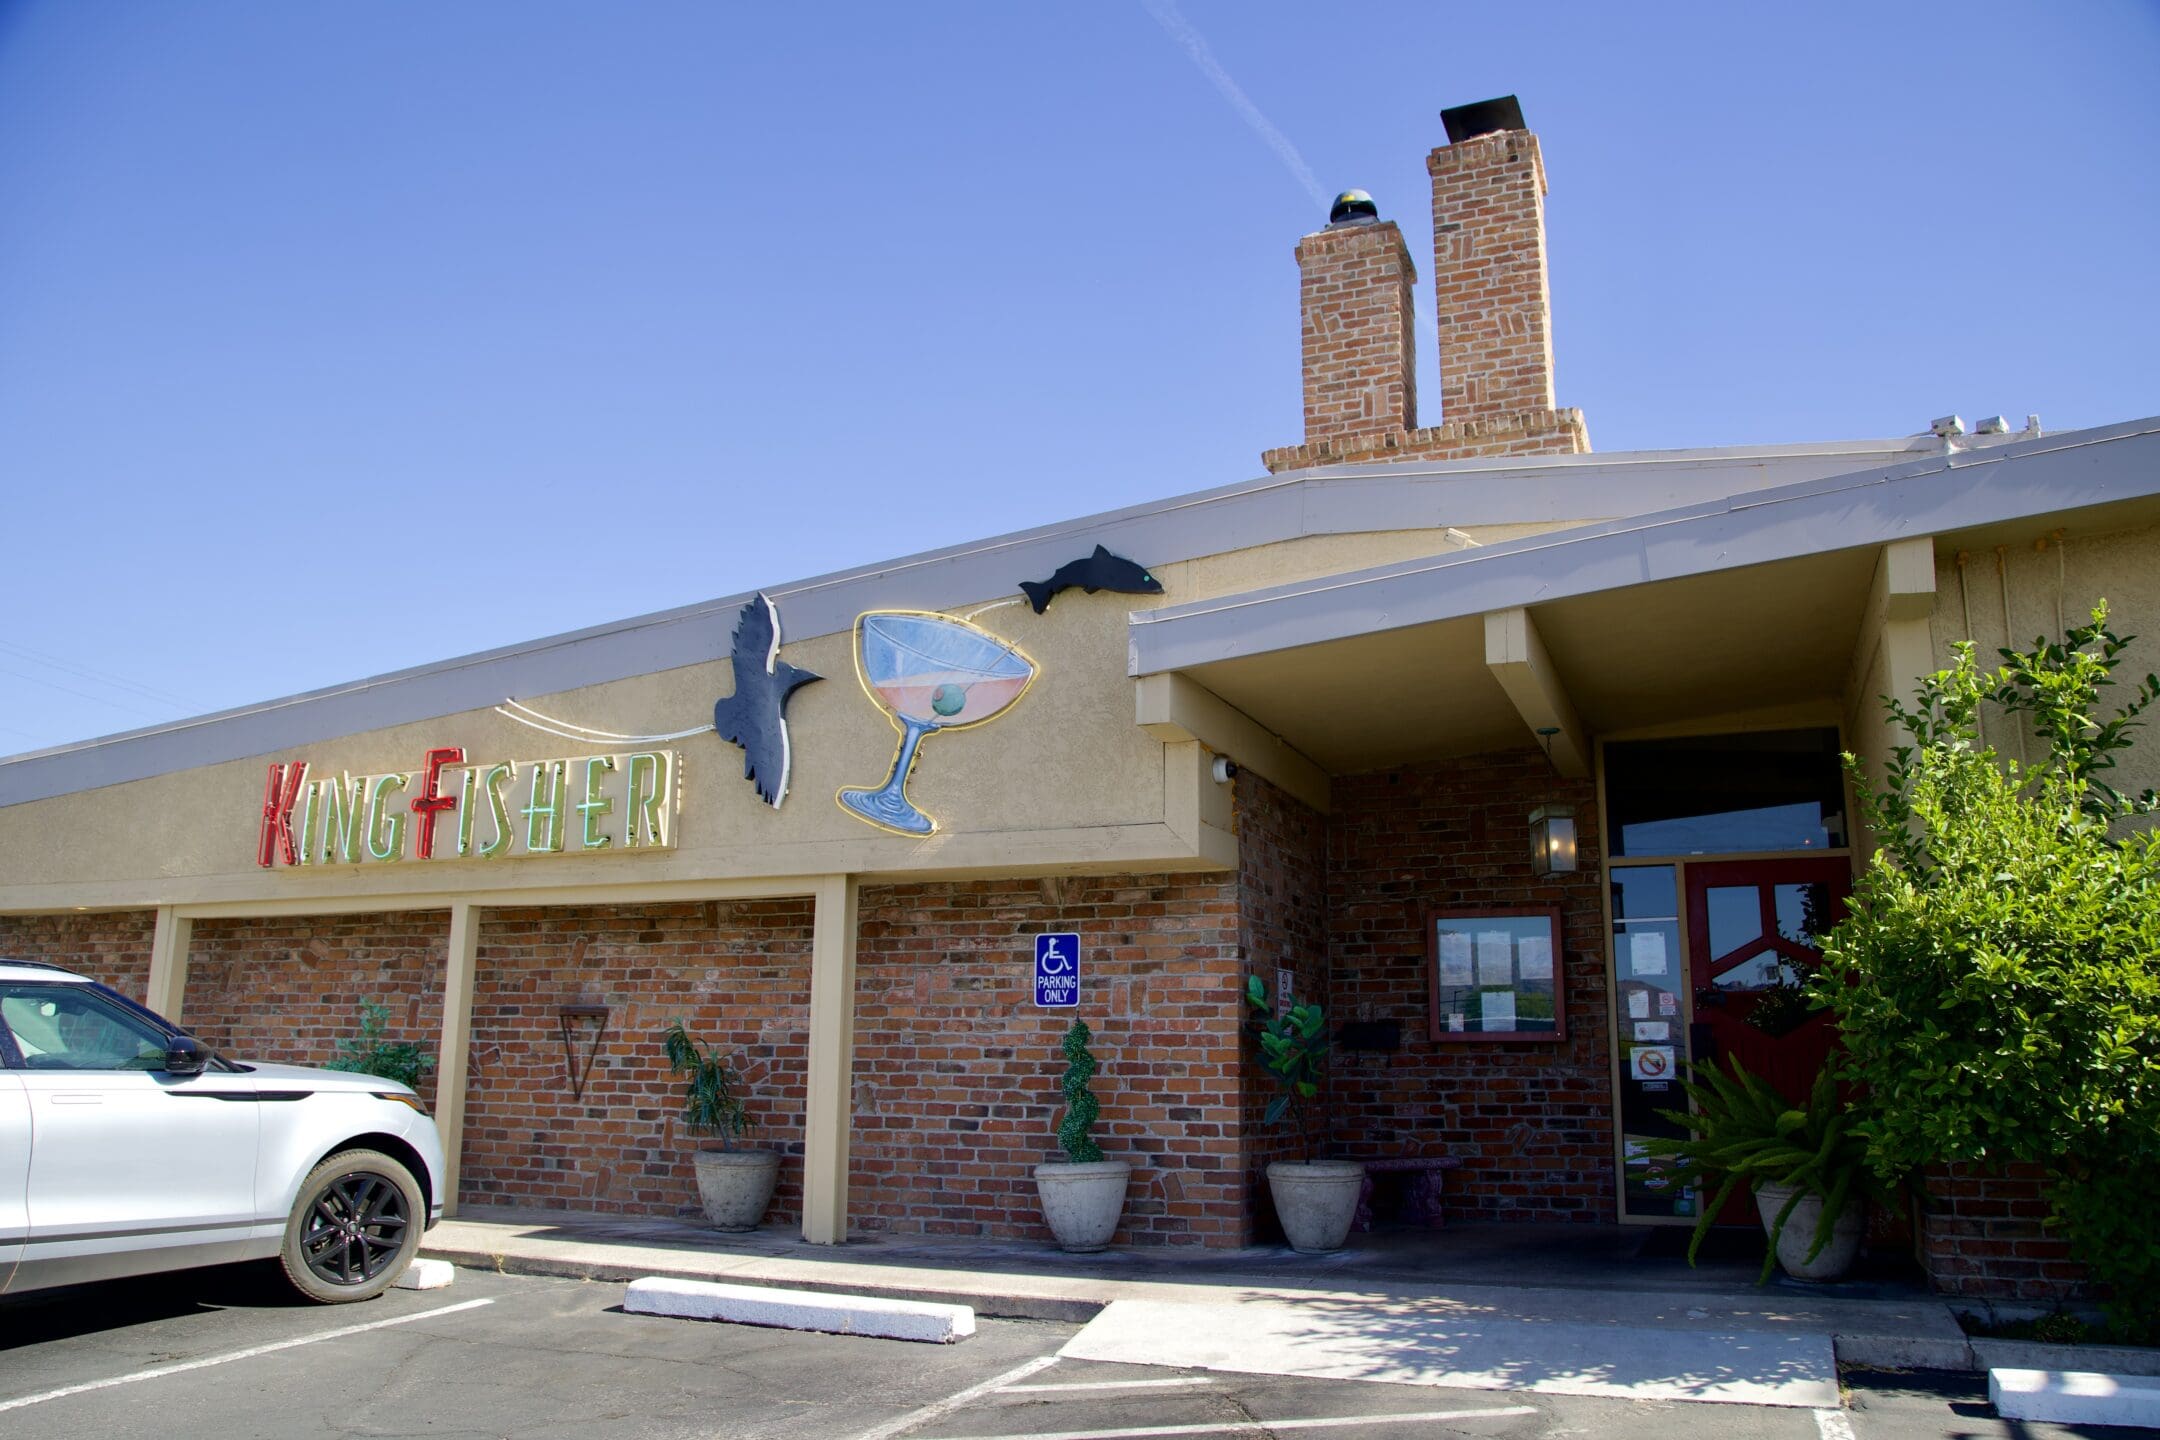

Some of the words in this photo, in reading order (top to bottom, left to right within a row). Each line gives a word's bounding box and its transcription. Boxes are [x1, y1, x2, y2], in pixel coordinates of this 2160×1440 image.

[258, 747, 672, 867] KINGFISHER
[1038, 975, 1076, 989] PARKING
[1044, 989, 1069, 1003] ONLY
